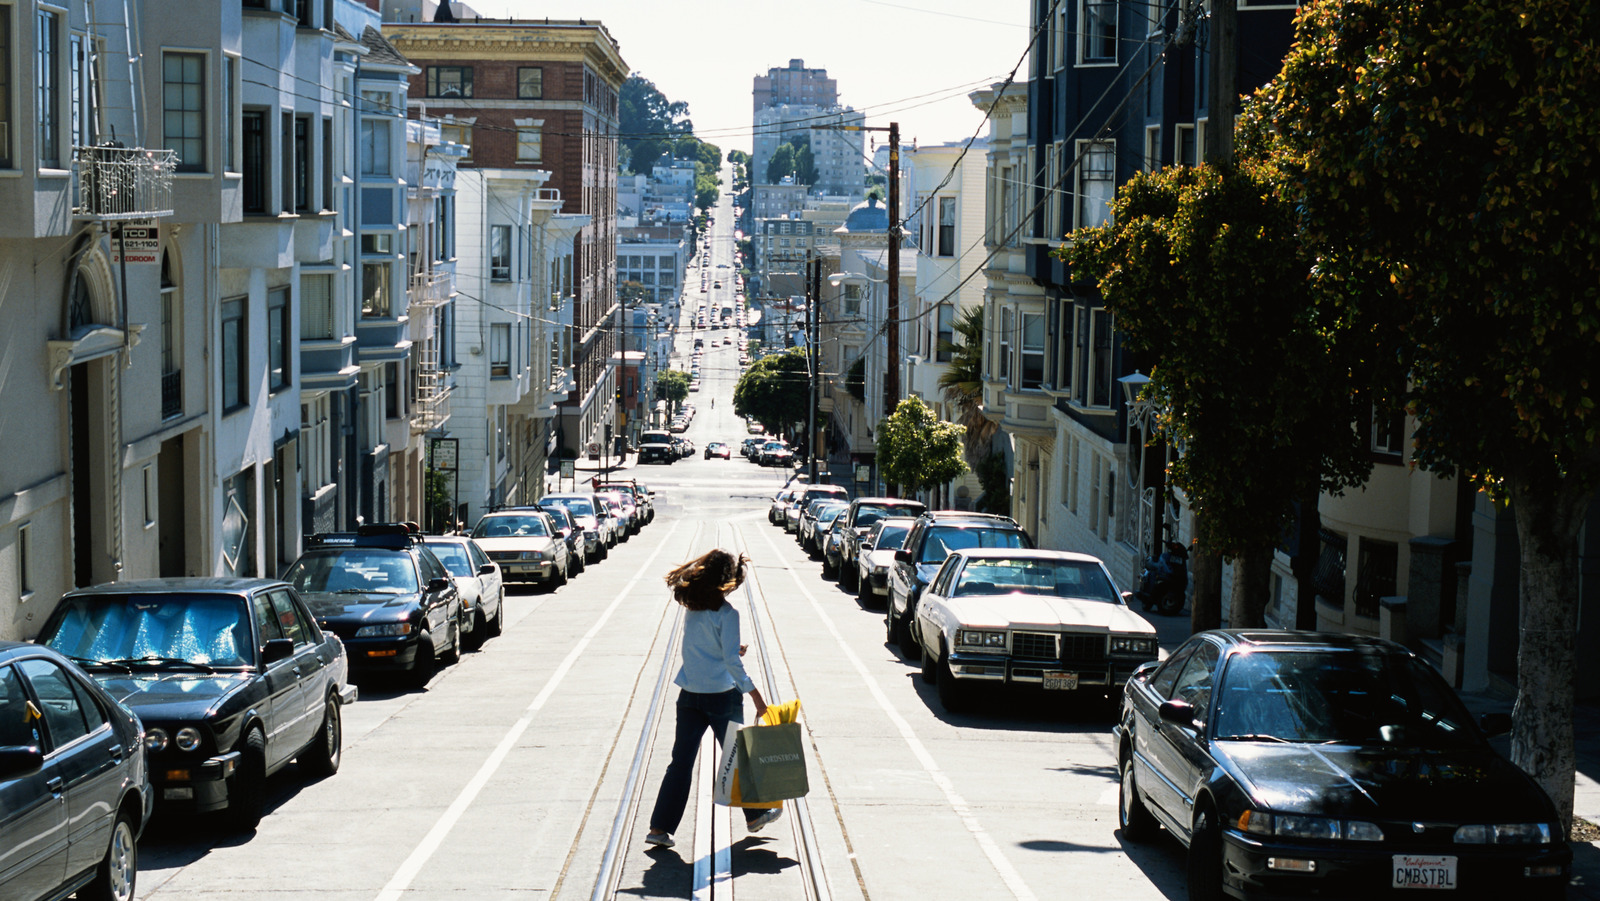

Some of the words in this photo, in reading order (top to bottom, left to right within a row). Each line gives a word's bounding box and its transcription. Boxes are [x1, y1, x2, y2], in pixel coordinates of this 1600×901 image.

[759, 753, 800, 764] NORDSTROM
[1406, 857, 1447, 868] California
[1396, 868, 1453, 886] CMBSTBL
